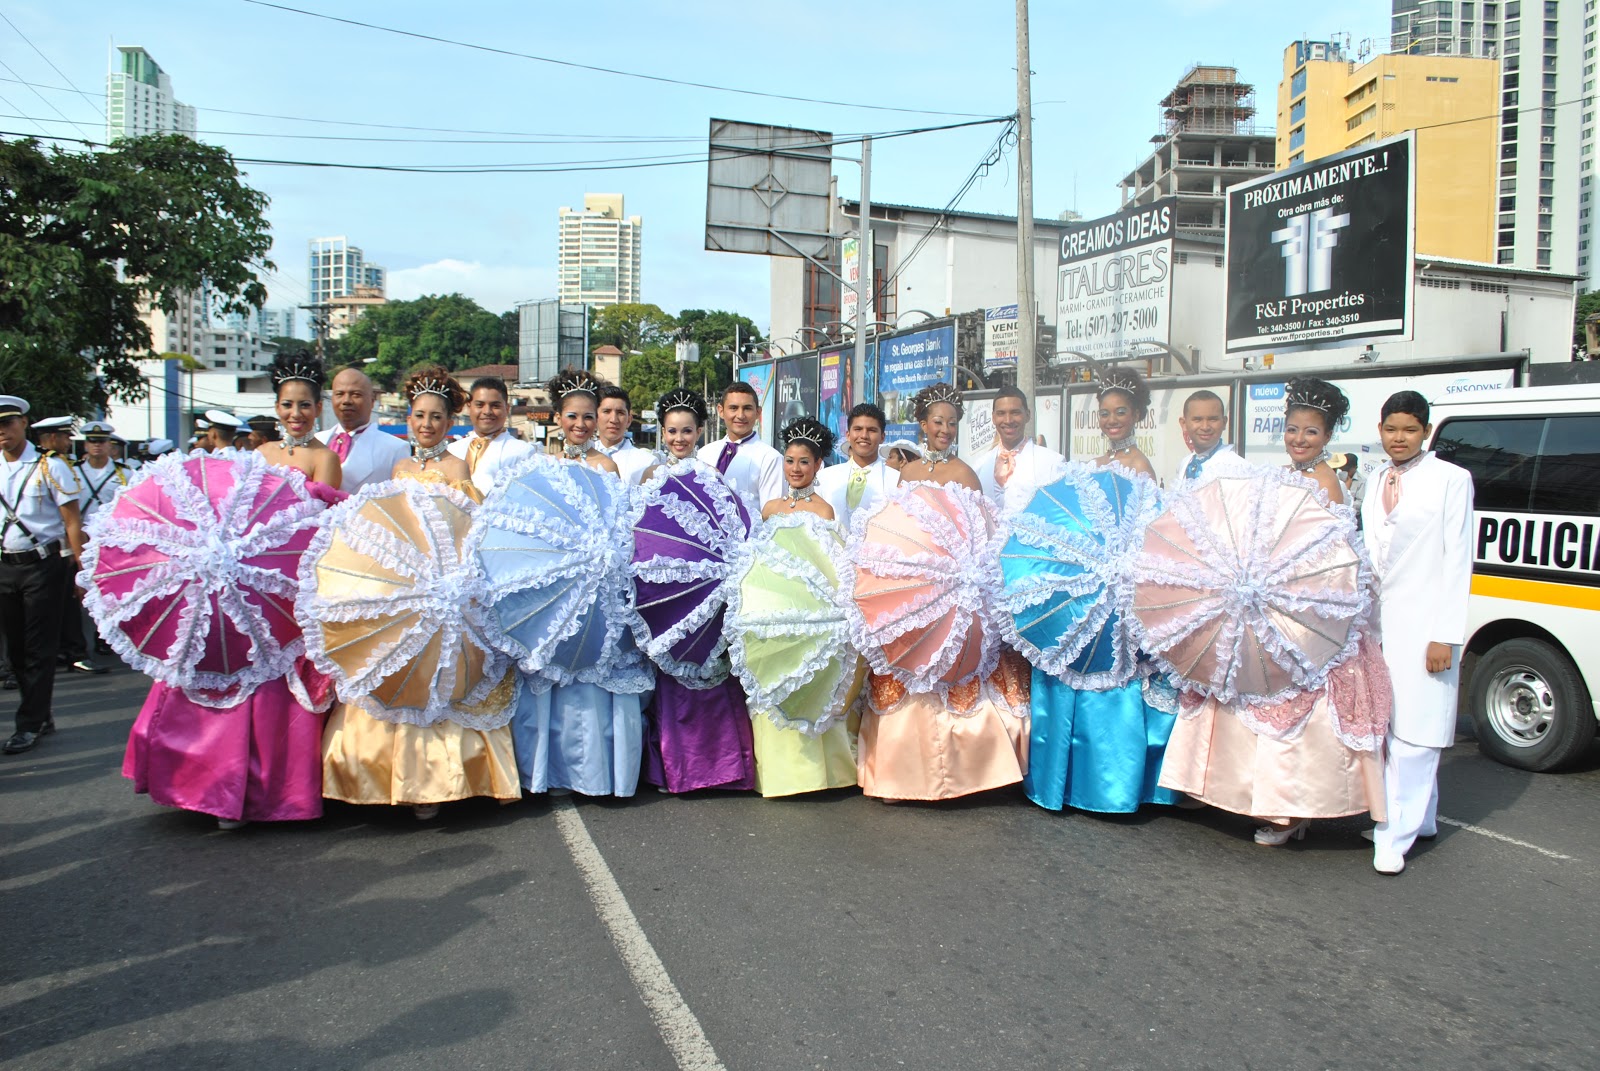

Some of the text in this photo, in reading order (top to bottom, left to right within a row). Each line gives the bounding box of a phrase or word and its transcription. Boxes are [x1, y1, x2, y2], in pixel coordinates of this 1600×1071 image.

[1278, 194, 1344, 218] Otra obra más de:
[1062, 206, 1171, 259] CREAMOS IDEAS
[1060, 246, 1168, 301] ITALGRES
[1060, 286, 1165, 315] MARMI GRANITI CERAMICHE
[1255, 291, 1365, 320] F&F Properties
[1066, 305, 1158, 340] Tel: (507) 297-5000
[1257, 326, 1270, 334] Tel:
[1271, 321, 1301, 332] 340-3500
[1308, 318, 1324, 328] Fax:
[1326, 313, 1360, 326] 340-3510
[1271, 328, 1344, 342] www.ffproperties.net
[892, 337, 941, 357] St. Georges Bank
[1092, 341, 1104, 350] CON
[884, 355, 949, 374] te regala una casa de playa
[1254, 405, 1284, 413] SENSODYNE
[1074, 410, 1100, 430] NO LOS
[1253, 413, 1286, 433] RÁPI
[1074, 436, 1084, 455] NO
[1087, 436, 1100, 455] LOS
